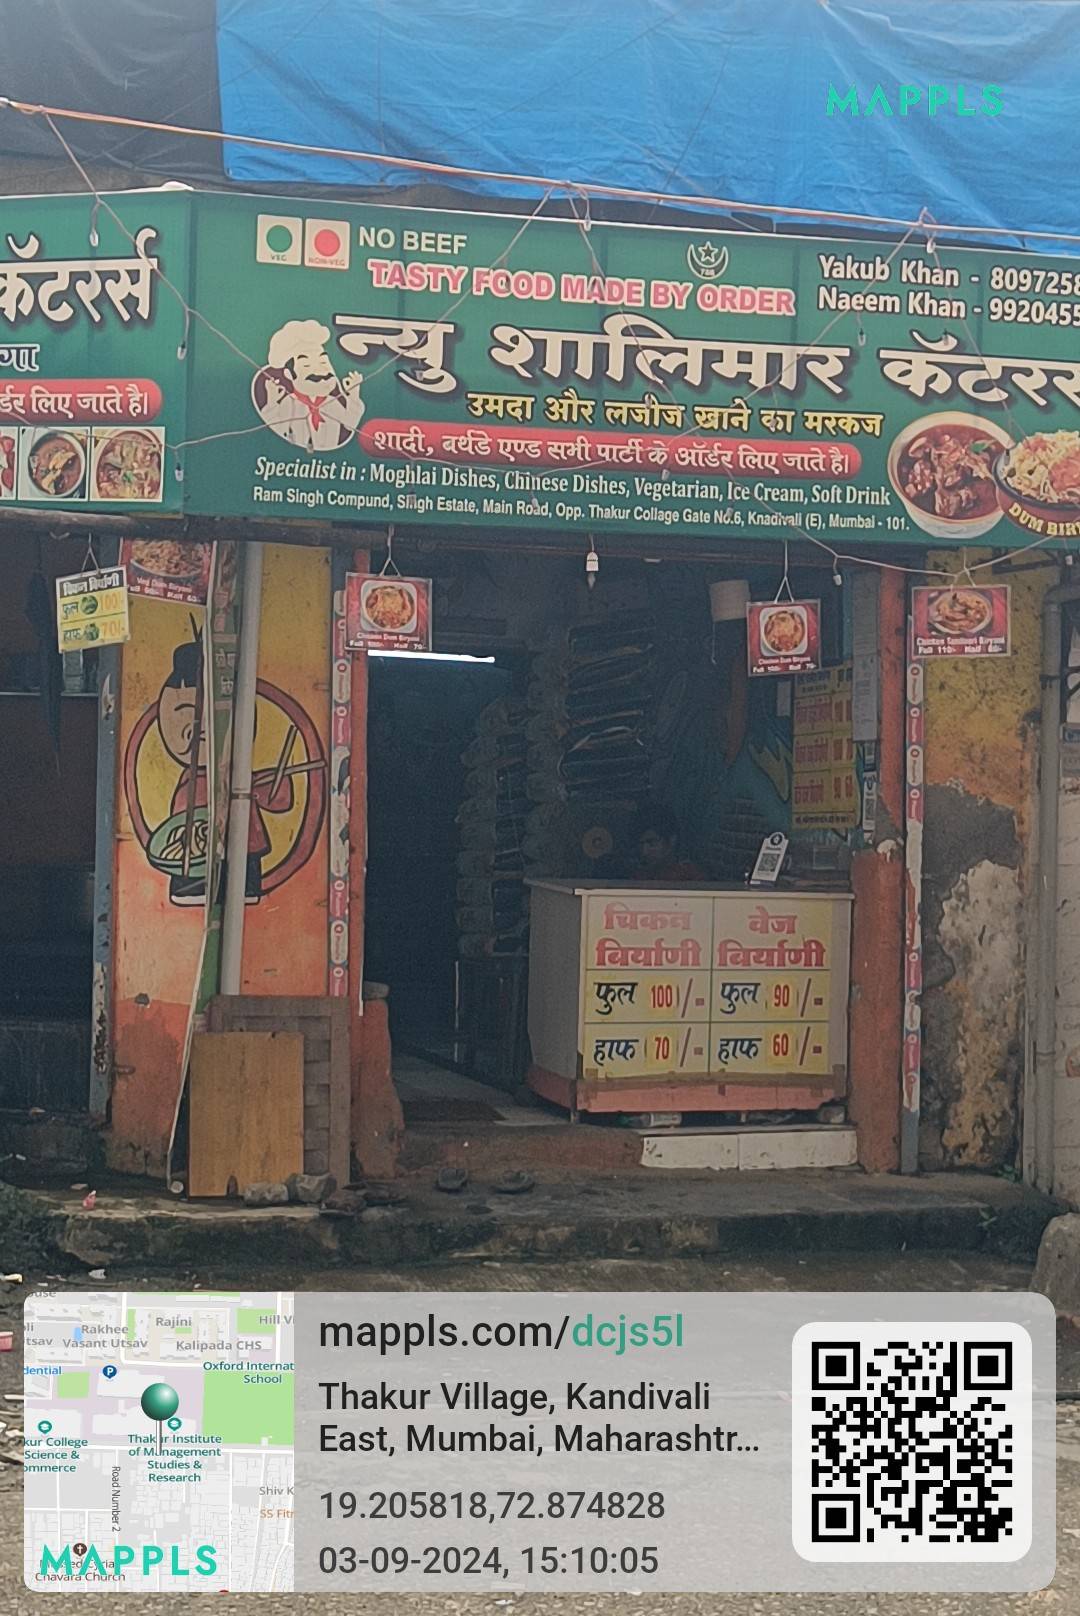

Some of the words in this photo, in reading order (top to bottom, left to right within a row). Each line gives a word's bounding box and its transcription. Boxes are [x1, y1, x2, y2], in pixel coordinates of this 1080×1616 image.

[359, 227, 395, 249] NO
[403, 231, 468, 255] BEEF
[818, 254, 890, 281] Yakub
[901, 260, 959, 287] Khan
[368, 259, 467, 293] TASTY
[473, 268, 554, 299] FOOD
[561, 274, 645, 305] MADE
[651, 280, 693, 310] BY
[697, 284, 796, 316] ORDER
[818, 286, 901, 314] Naeem
[908, 292, 966, 319] Khan
[335, 315, 457, 393] न्यु
[490, 313, 850, 394] शालिमार
[30, 385, 73, 419] लिए
[77, 386, 123, 414] जाते
[467, 392, 535, 421] उमदा
[545, 388, 595, 424] और
[694, 398, 751, 432] खाने
[760, 409, 795, 433] का
[804, 411, 884, 437] मरकज
[374, 425, 434, 456] शादी,
[497, 438, 542, 462] एण्ड
[547, 435, 593, 462] सभी
[596, 437, 643, 464] पार्टी
[647, 441, 670, 465] के
[675, 441, 735, 469] ऑर्डर
[737, 442, 780, 474] लिए
[783, 445, 826, 472] जाते
[255, 456, 337, 481] Specialist
[340, 463, 356, 481] in
[370, 463, 437, 488] Moghlai
[442, 467, 500, 491] Dishes,
[504, 470, 568, 492] Chinese
[572, 474, 630, 498] Dishes,
[634, 476, 723, 501] Vegetarian,
[727, 481, 750, 500] Ice
[754, 482, 808, 505] Cream,
[811, 484, 842, 503] Soft
[846, 486, 891, 506] Drink
[253, 486, 283, 502] Ram
[287, 488, 323, 507] Singh
[327, 490, 394, 511] Compund,
[437, 497, 479, 514] Estate,
[483, 499, 513, 514] Main
[516, 500, 552, 518] Road,
[556, 502, 585, 521] Opp.
[588, 504, 630, 519] Thakur
[633, 505, 679, 524] Collage
[682, 507, 710, 523] Gate
[829, 513, 875, 529] Mumbai
[886, 516, 910, 530] 101.
[1008, 502, 1044, 532] DUM
[604, 902, 692, 930] चिकन
[748, 905, 798, 934] वेज
[593, 982, 638, 1015] फुल
[720, 982, 761, 1015] फुल
[593, 1038, 639, 1066] हाफ
[717, 1038, 762, 1064] हाफ
